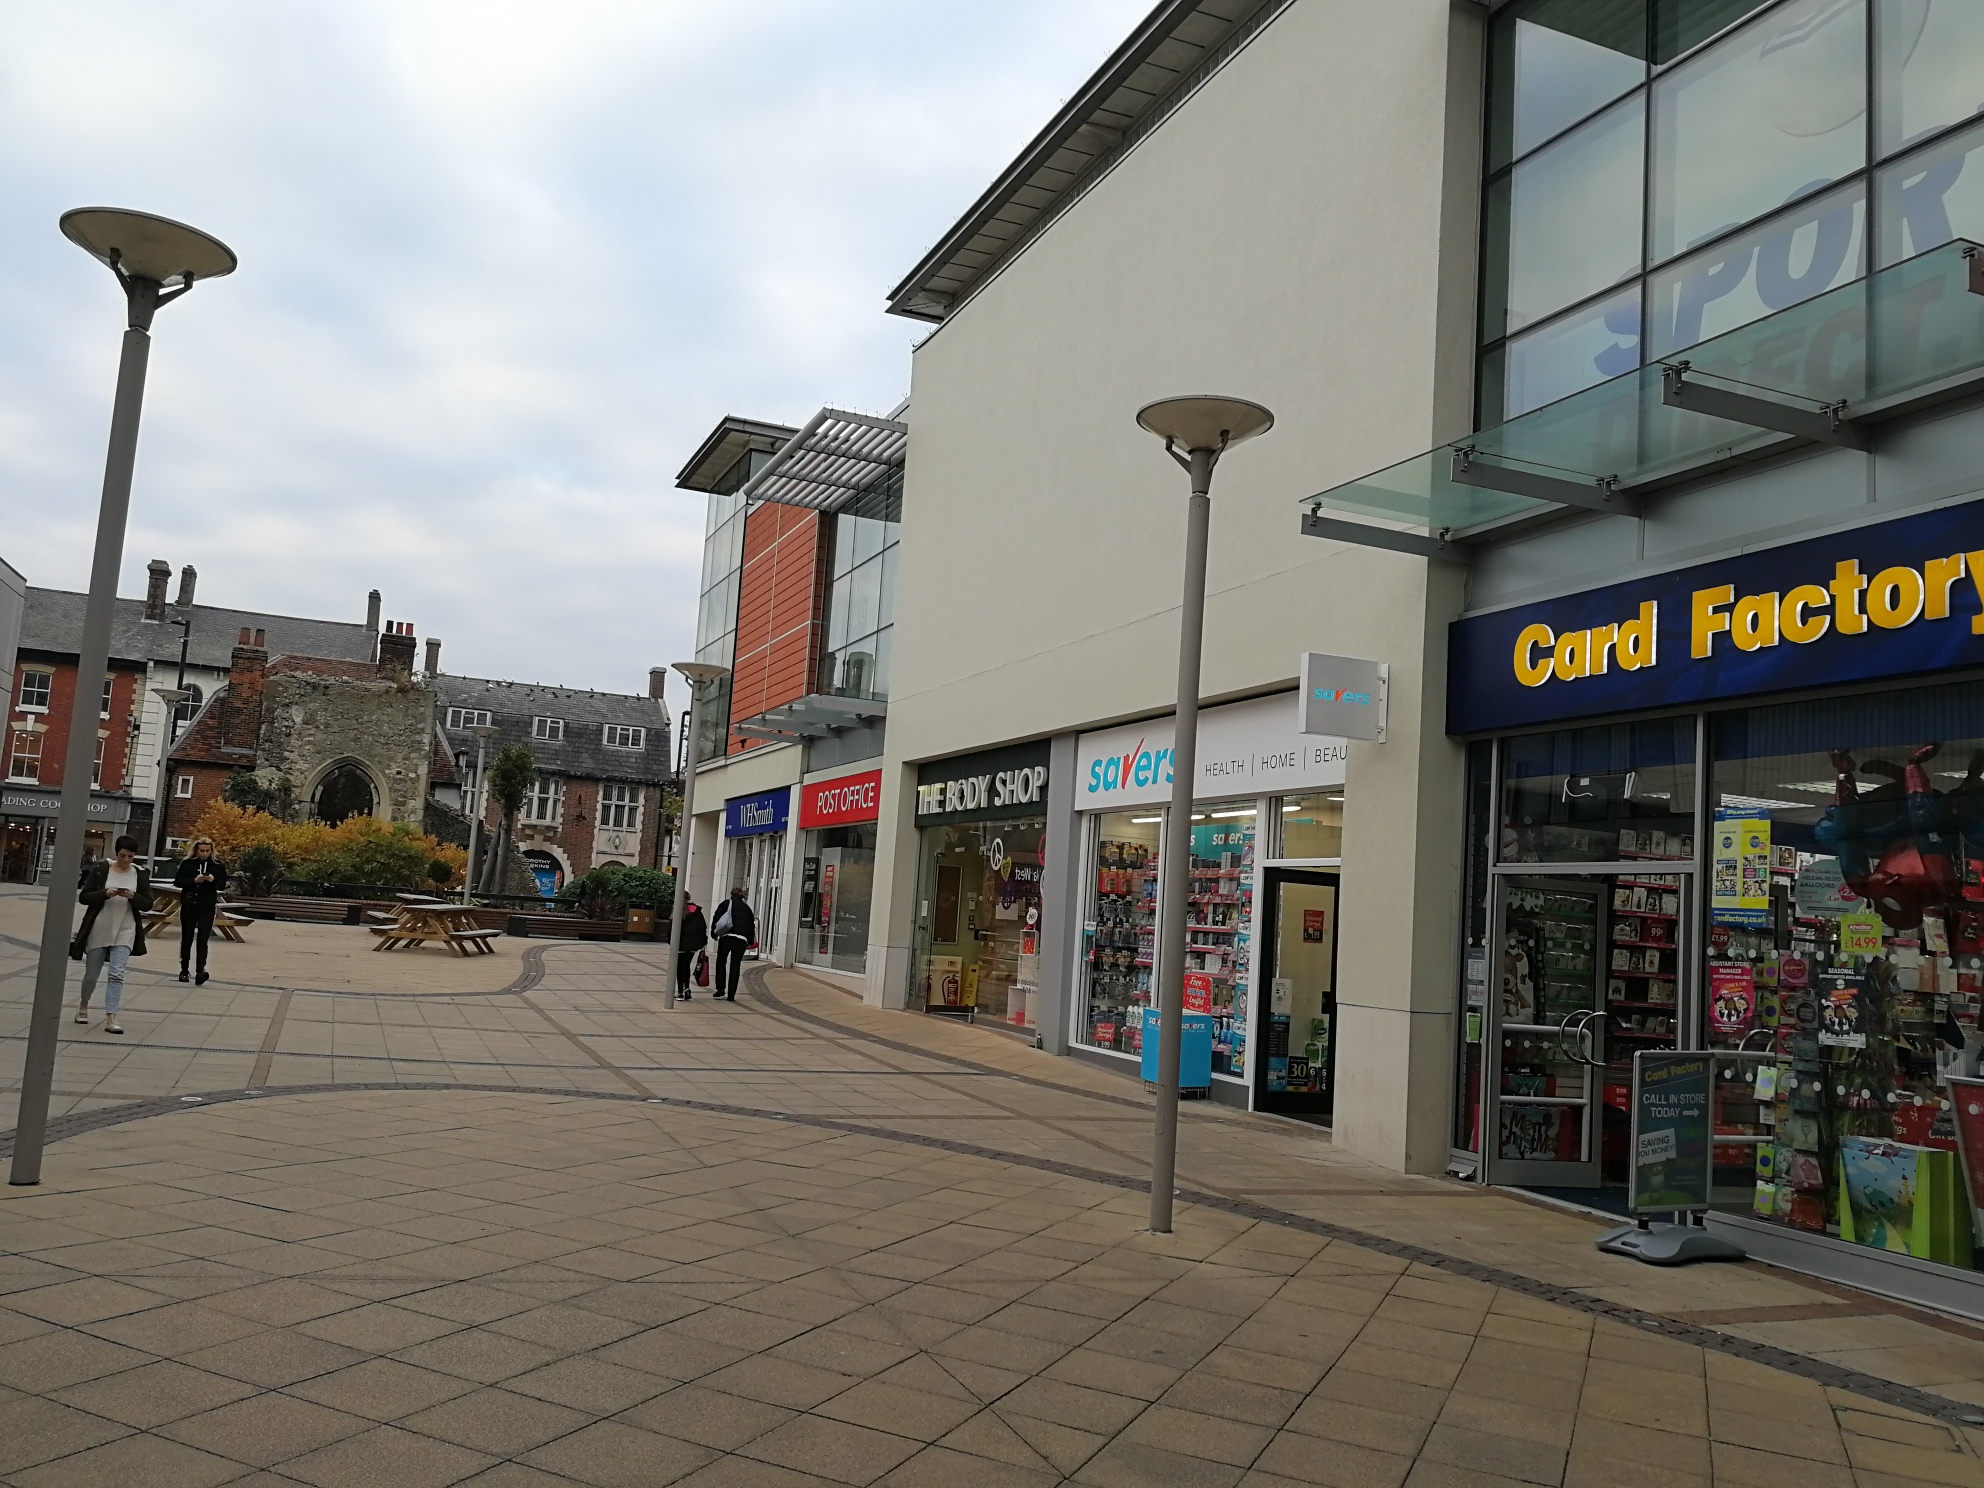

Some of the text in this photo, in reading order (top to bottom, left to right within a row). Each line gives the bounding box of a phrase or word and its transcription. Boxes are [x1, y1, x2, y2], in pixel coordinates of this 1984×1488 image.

[1594, 100, 1984, 378] SPOR
[1513, 600, 1658, 688] Card
[1313, 687, 1370, 705] savers
[1205, 745, 1347, 777] HEALTH HOME BEAU
[918, 766, 1048, 815] THE BODY SHOP
[2, 796, 36, 807] ADING
[816, 782, 876, 814] POST OFFICE
[740, 799, 774, 828] WHSmith
[1759, 869, 1765, 877] 6
[1714, 914, 1767, 923] cardfactory.co.uk
[1711, 934, 1728, 942] £1.99
[1290, 1063, 1307, 1077] 30
[1645, 1060, 1704, 1082] Card Factory
[1643, 1093, 1706, 1104] CALL IN STORE
[1650, 1107, 1681, 1118] TODAY
[1895, 1126, 1907, 1135] gs
[1641, 1135, 1670, 1149] SAVING
